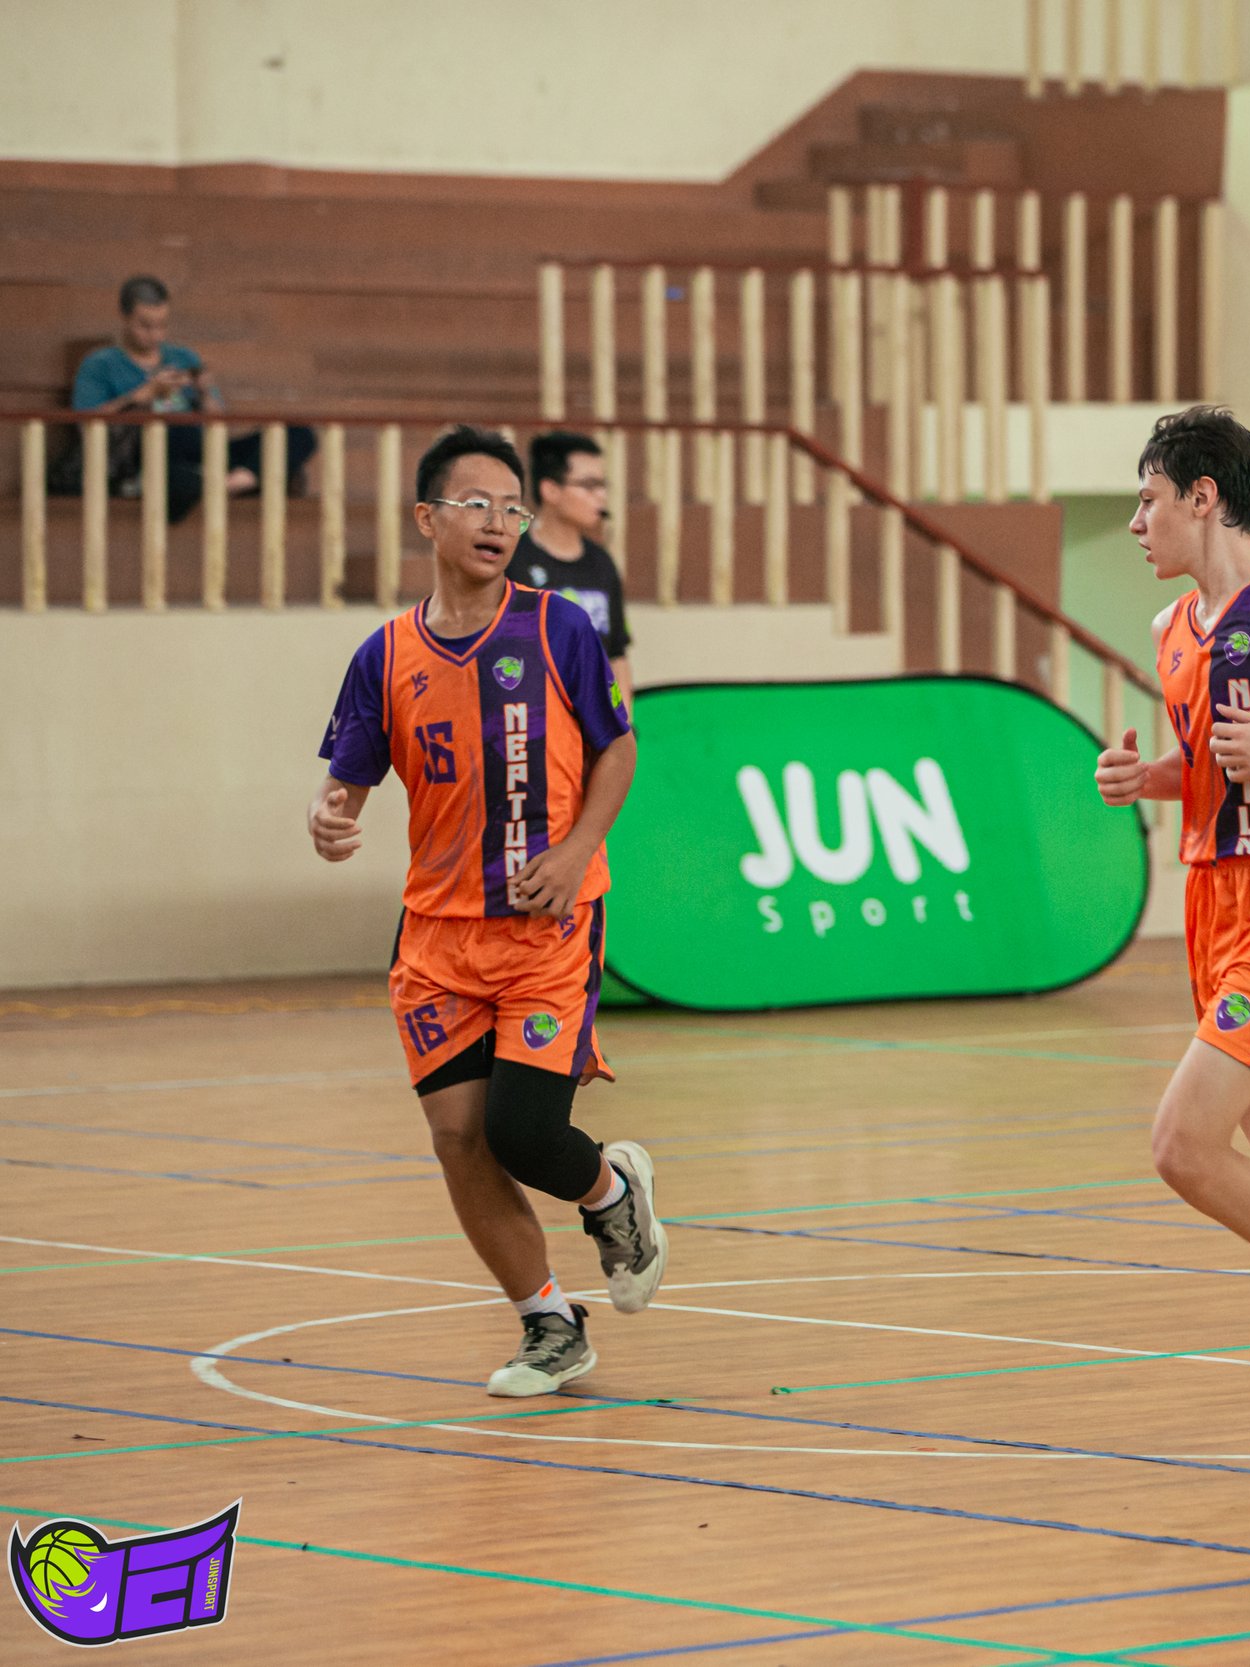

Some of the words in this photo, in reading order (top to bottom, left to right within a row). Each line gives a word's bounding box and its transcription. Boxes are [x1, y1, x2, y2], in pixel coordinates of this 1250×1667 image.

[415, 720, 457, 784] 16
[736, 757, 970, 889] JUN
[404, 1003, 449, 1057] 16
